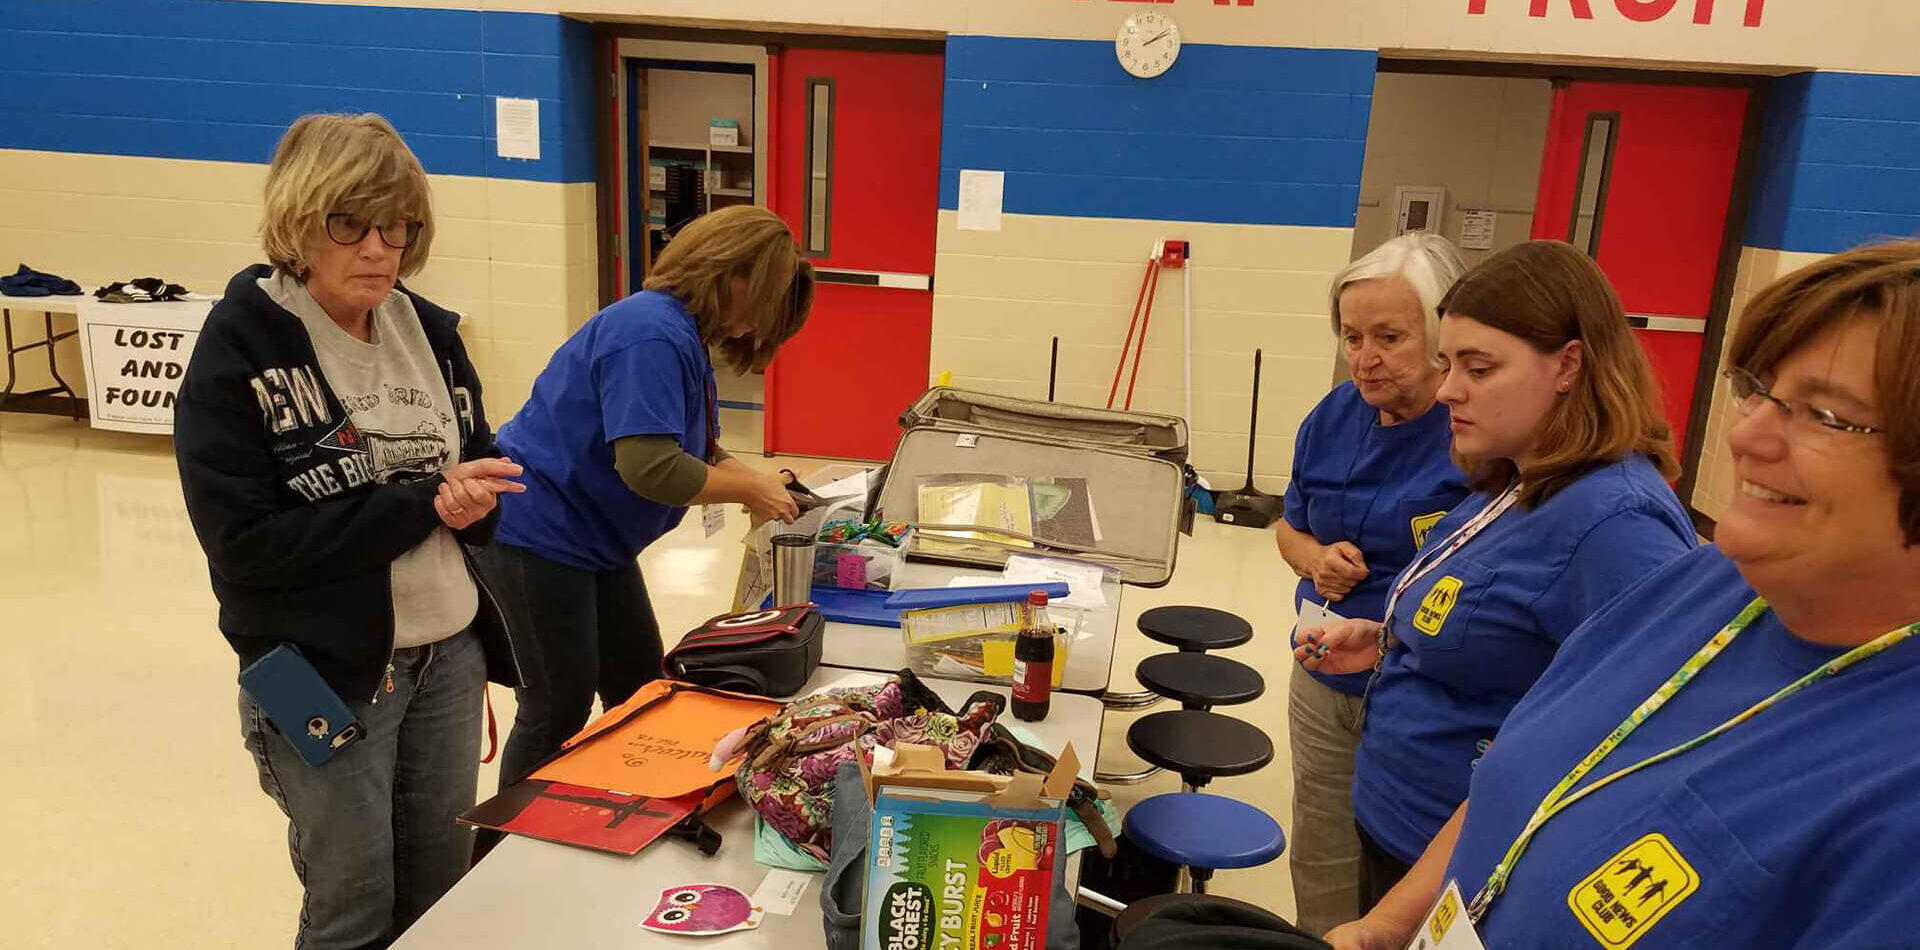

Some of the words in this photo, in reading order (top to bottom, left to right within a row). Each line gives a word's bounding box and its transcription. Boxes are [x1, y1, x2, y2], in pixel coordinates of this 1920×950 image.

[1146, 15, 1154, 23] 12
[114, 328, 184, 350] LOST
[121, 359, 183, 379] AND
[106, 387, 177, 408] FOUN
[287, 463, 344, 502] THE
[991, 851, 1000, 874] Liquid
[940, 859, 967, 929] BURST
[972, 894, 982, 914] JUICE
[1593, 879, 1615, 903] GOOD
[1609, 900, 1638, 928] NEWS
[887, 892, 907, 950] BLACK
[1591, 899, 1615, 924] CLUB
[1009, 913, 1021, 942] Fruit
